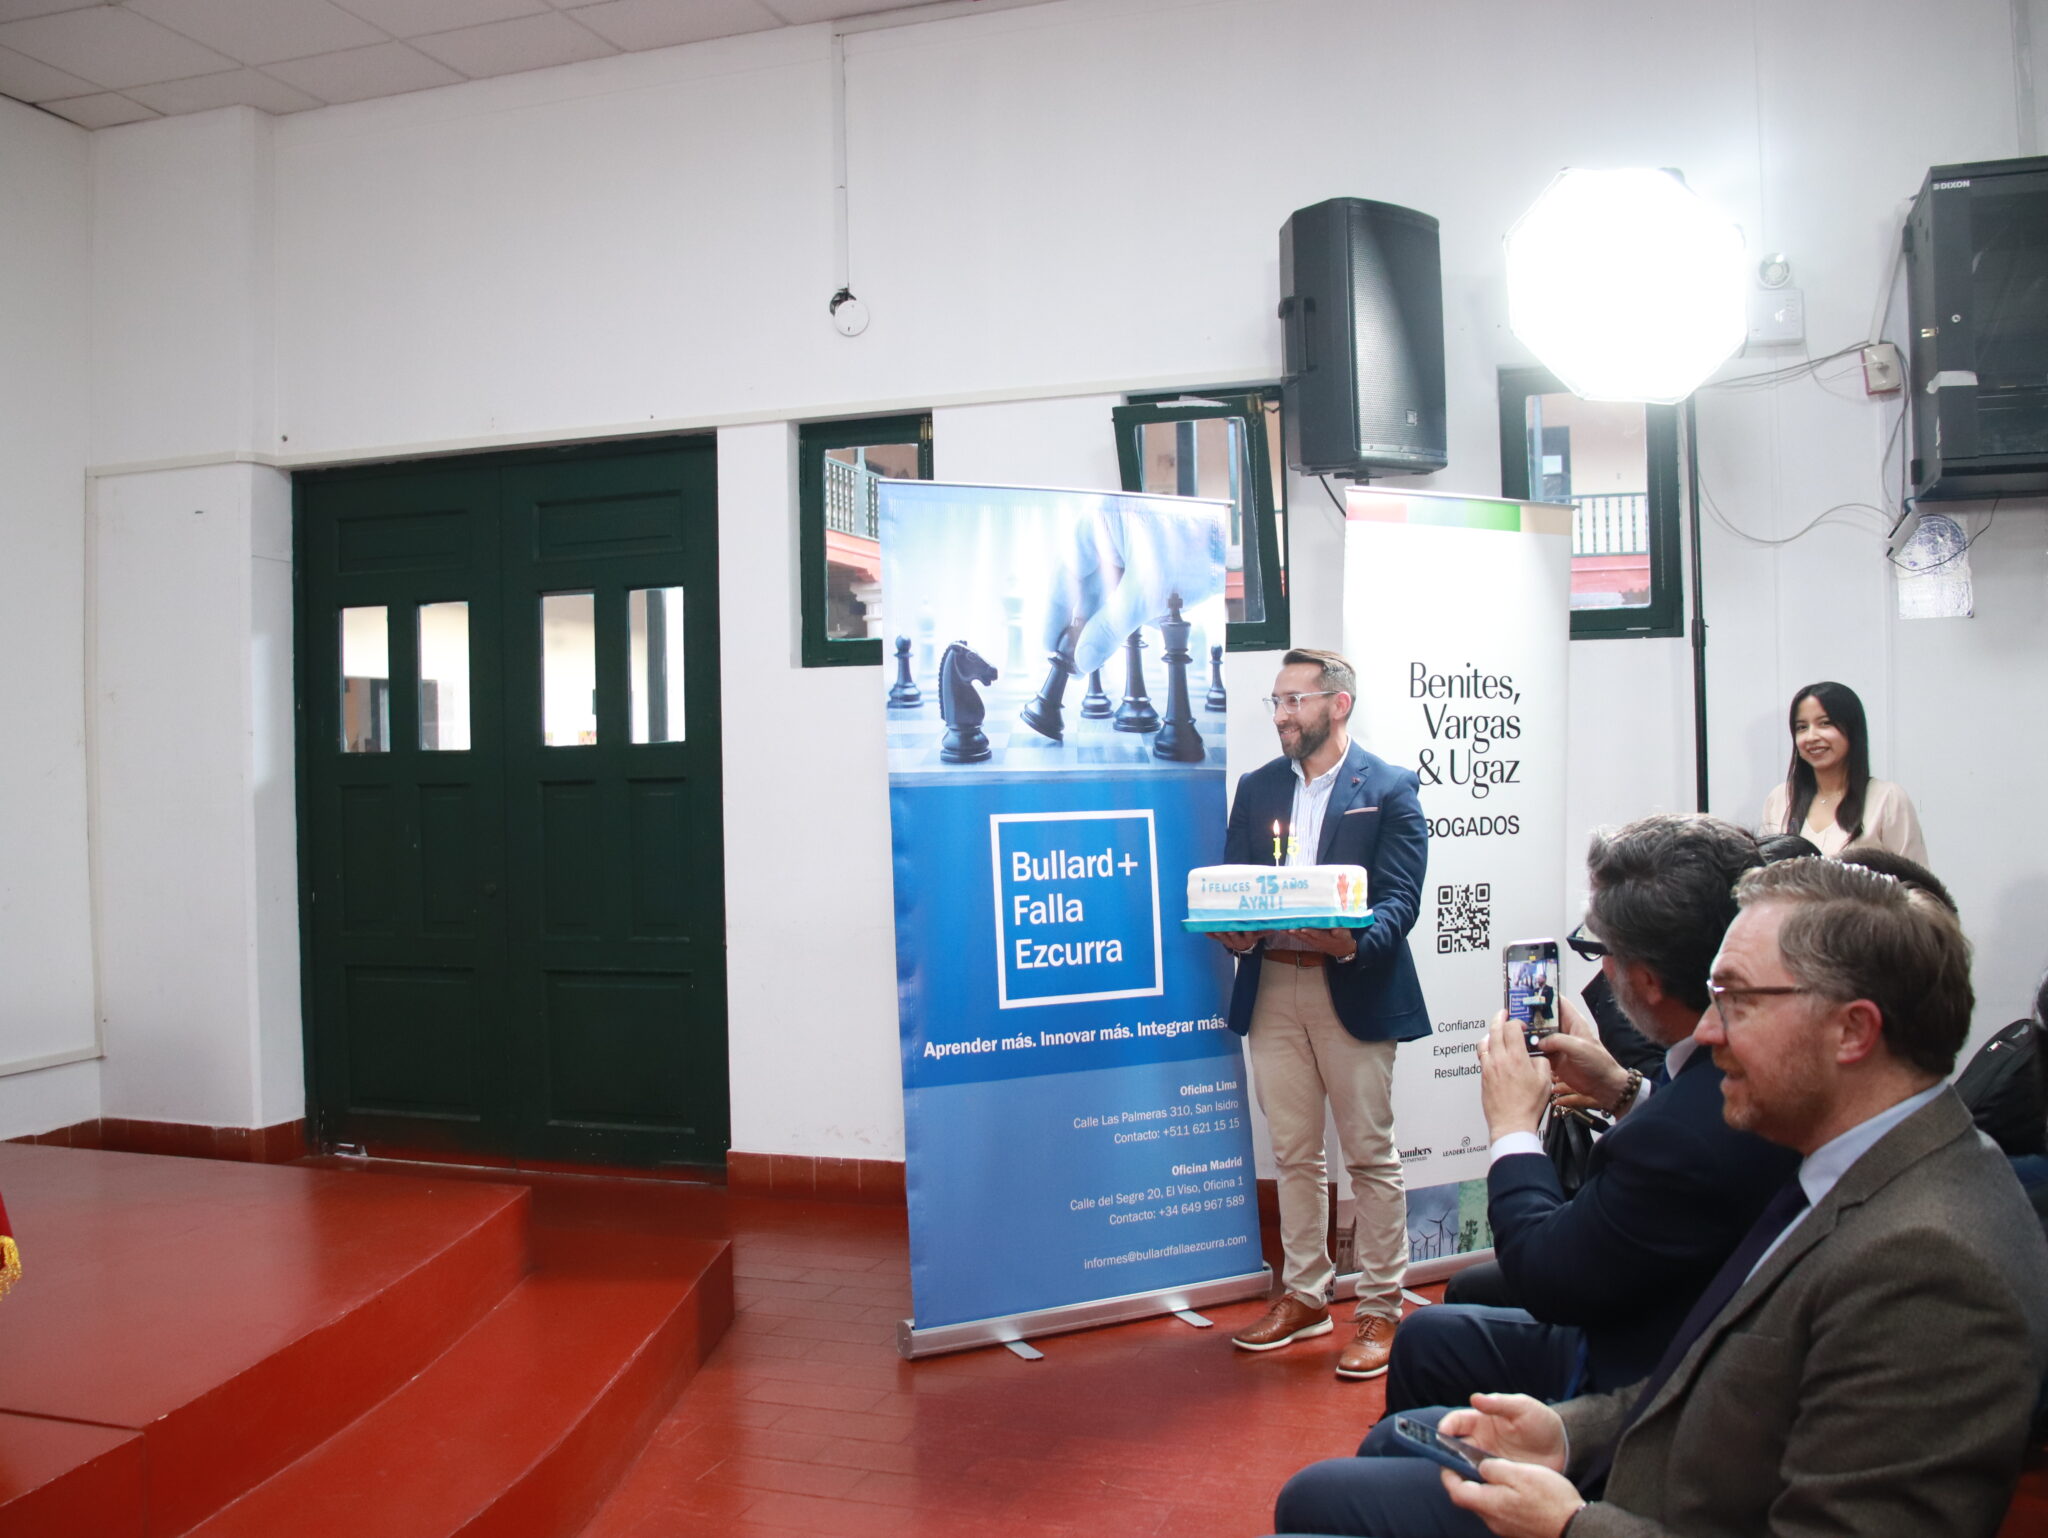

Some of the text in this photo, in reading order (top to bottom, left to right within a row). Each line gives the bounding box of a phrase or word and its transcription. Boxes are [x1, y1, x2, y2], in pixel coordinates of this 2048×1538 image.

[1940, 180, 1970, 190] DIXON
[1410, 661, 1521, 704] Benites,
[1423, 703, 1521, 753] Vargas
[1417, 748, 1520, 798] & Ugaz
[1425, 815, 1520, 838] BOGADOS
[1256, 875, 1279, 894] 15
[1014, 894, 1083, 926] Falla
[1016, 938, 1122, 969] Ezcurra
[923, 1015, 1228, 1060] Aprender más. Innovar más. Integrar más.
[1438, 1020, 1485, 1032] Confianza
[1433, 1043, 1477, 1057] Experien
[1435, 1064, 1482, 1078] Resultado
[1180, 1080, 1237, 1096] Oficina Lima
[1073, 1117, 1098, 1128] Calle
[1102, 1114, 1119, 1126] Las
[1121, 1109, 1167, 1122] Palmeras
[1195, 1103, 1213, 1114] San
[1216, 1100, 1238, 1111] Isidro
[1114, 1118, 1240, 1144] Contacto: +511 621 15 15
[1398, 1147, 1432, 1158] hambers
[1443, 1145, 1487, 1157] LEADERS LEAGUE
[1172, 1157, 1242, 1176] Oficina Madrid
[1070, 1198, 1095, 1211] Calle
[1098, 1196, 1113, 1207] del
[1115, 1192, 1145, 1206] Segre
[1166, 1186, 1176, 1197] El
[1177, 1183, 1200, 1195] Viso,
[1203, 1179, 1235, 1192] Oficina
[1109, 1195, 1244, 1225] Contacto: +34 649 967 589
[1084, 1234, 1247, 1270] informes@bullardfallaezcurra.com
